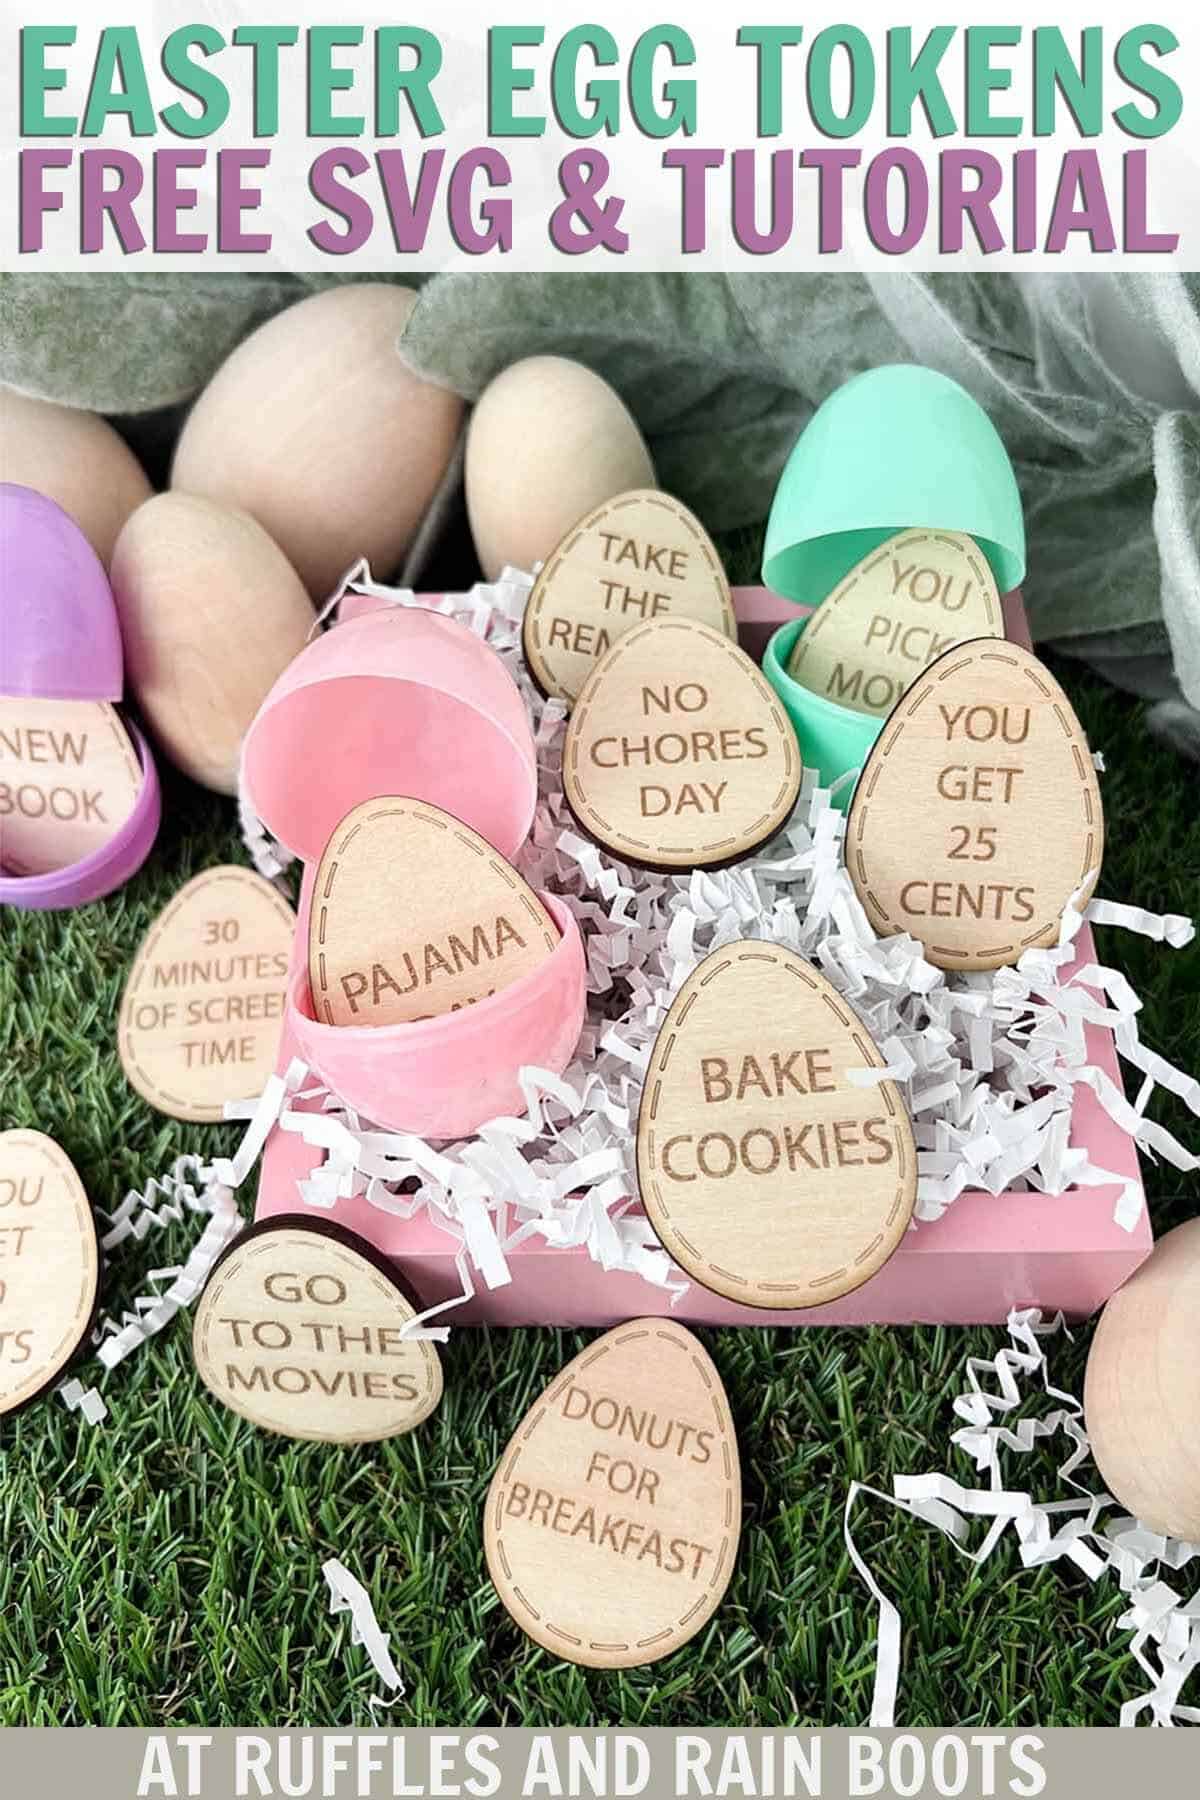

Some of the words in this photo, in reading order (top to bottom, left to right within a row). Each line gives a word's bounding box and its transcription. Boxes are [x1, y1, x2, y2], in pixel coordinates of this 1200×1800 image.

[599, 532, 689, 581] TAKE
[892, 559, 973, 612] YOU
[864, 615, 957, 664] PICK
[641, 683, 708, 715] NO
[938, 704, 1031, 744] YOU
[0, 728, 88, 765] NEW
[590, 727, 768, 768] CHORES
[0, 782, 109, 823] BOOK
[640, 781, 728, 817] DAY
[937, 765, 1025, 803] GET
[946, 825, 998, 861] 25
[900, 880, 1035, 922] CENTS
[203, 919, 240, 945] 30
[153, 952, 289, 988] MINUTES
[339, 916, 527, 1014] PAJAMA
[135, 1003, 177, 1031] OF
[186, 991, 287, 1026] SCREE
[179, 1036, 257, 1068] TIME
[701, 1049, 836, 1103] BAKE
[661, 1117, 893, 1182] COOKIES
[264, 1272, 347, 1306] GO
[219, 1318, 293, 1349] TO
[300, 1322, 407, 1357] THE
[225, 1363, 419, 1401] MOVIES
[561, 1385, 715, 1464] DONUTS
[586, 1450, 660, 1505] FOR
[504, 1481, 713, 1580] BREAKFAST
